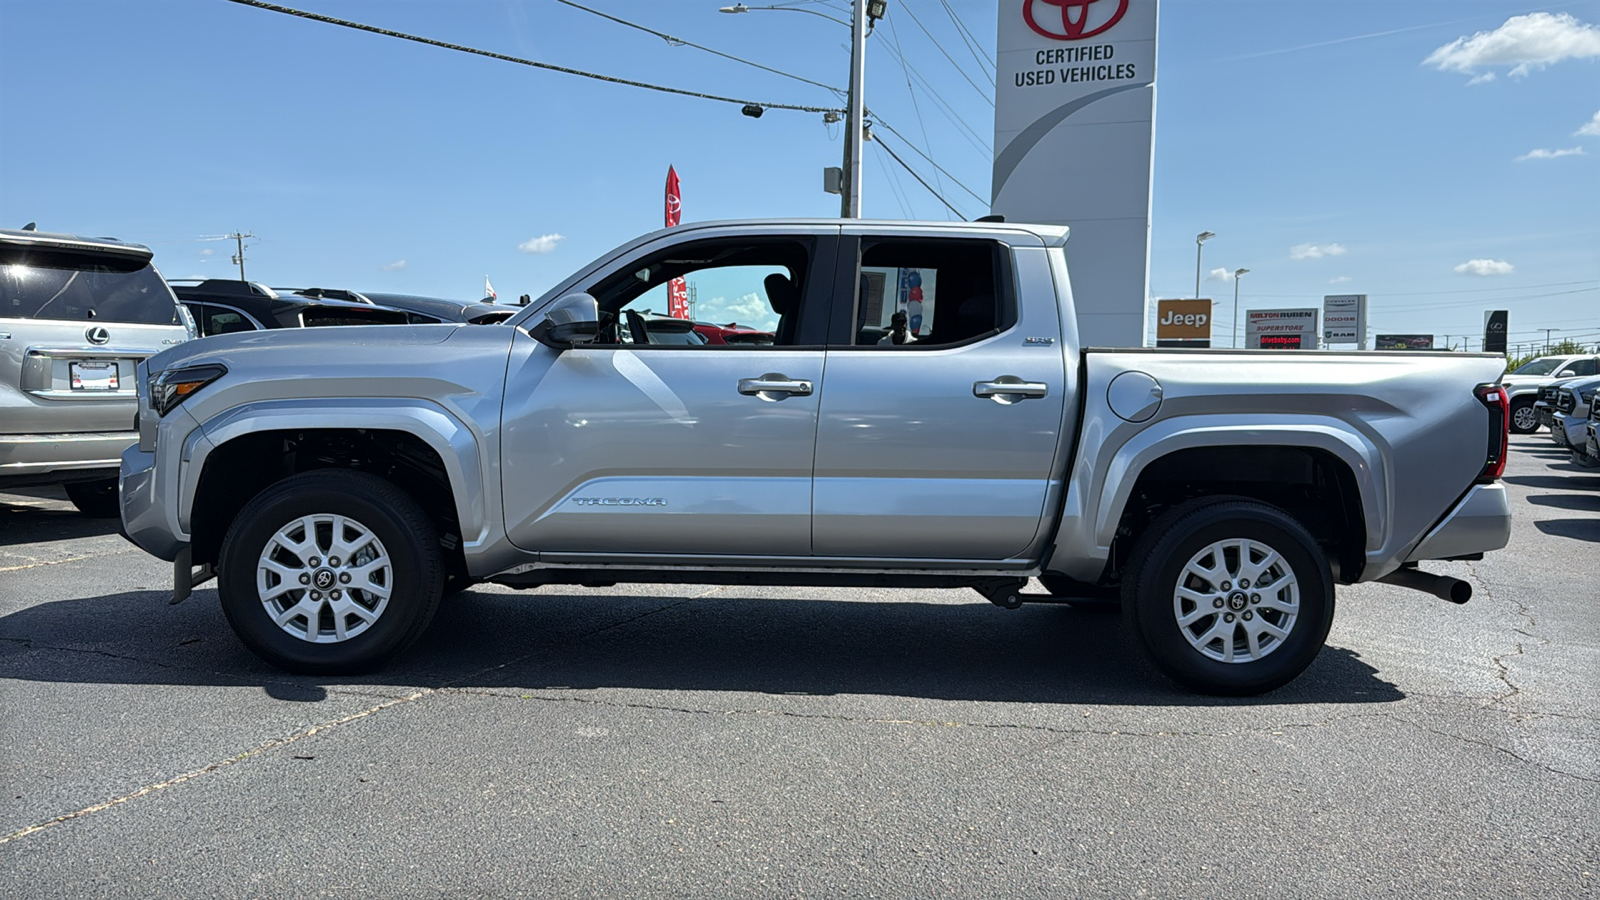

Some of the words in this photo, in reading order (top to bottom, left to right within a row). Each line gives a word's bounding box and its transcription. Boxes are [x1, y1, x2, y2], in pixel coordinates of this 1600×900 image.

[1036, 45, 1114, 65] CERTIFIED
[1015, 70, 1055, 87] USED
[1060, 63, 1135, 83] VEHICLES
[1160, 310, 1207, 328] Jeep
[1261, 336, 1300, 344] drivebaby.com
[572, 498, 667, 506] TACOMA
